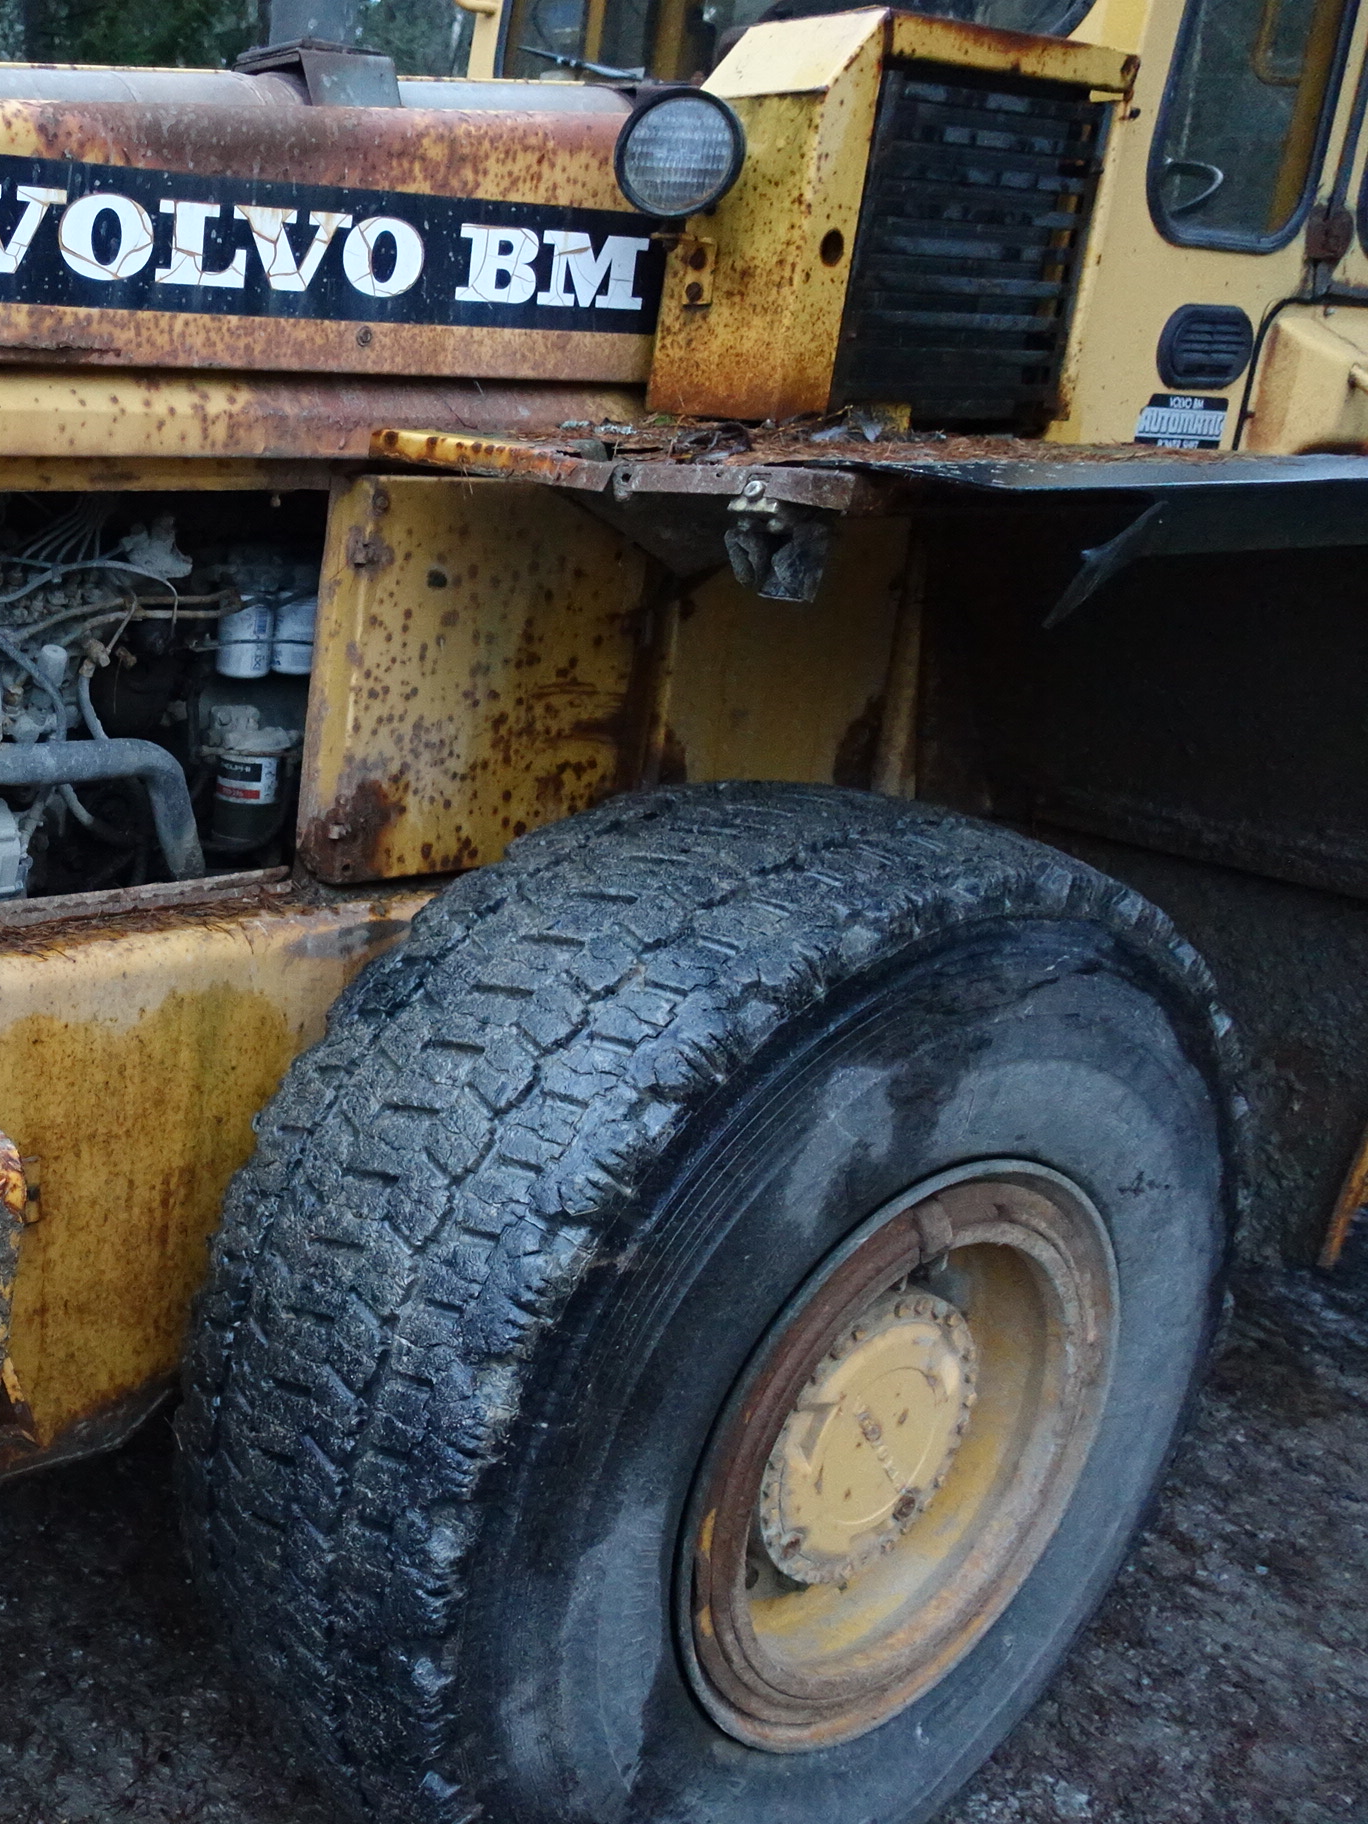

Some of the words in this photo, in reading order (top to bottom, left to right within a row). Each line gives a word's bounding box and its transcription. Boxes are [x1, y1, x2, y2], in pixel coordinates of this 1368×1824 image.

[455, 223, 650, 310] BM
[1169, 396, 1192, 409] VOLVO
[1138, 409, 1225, 437] AUTOMATIC
